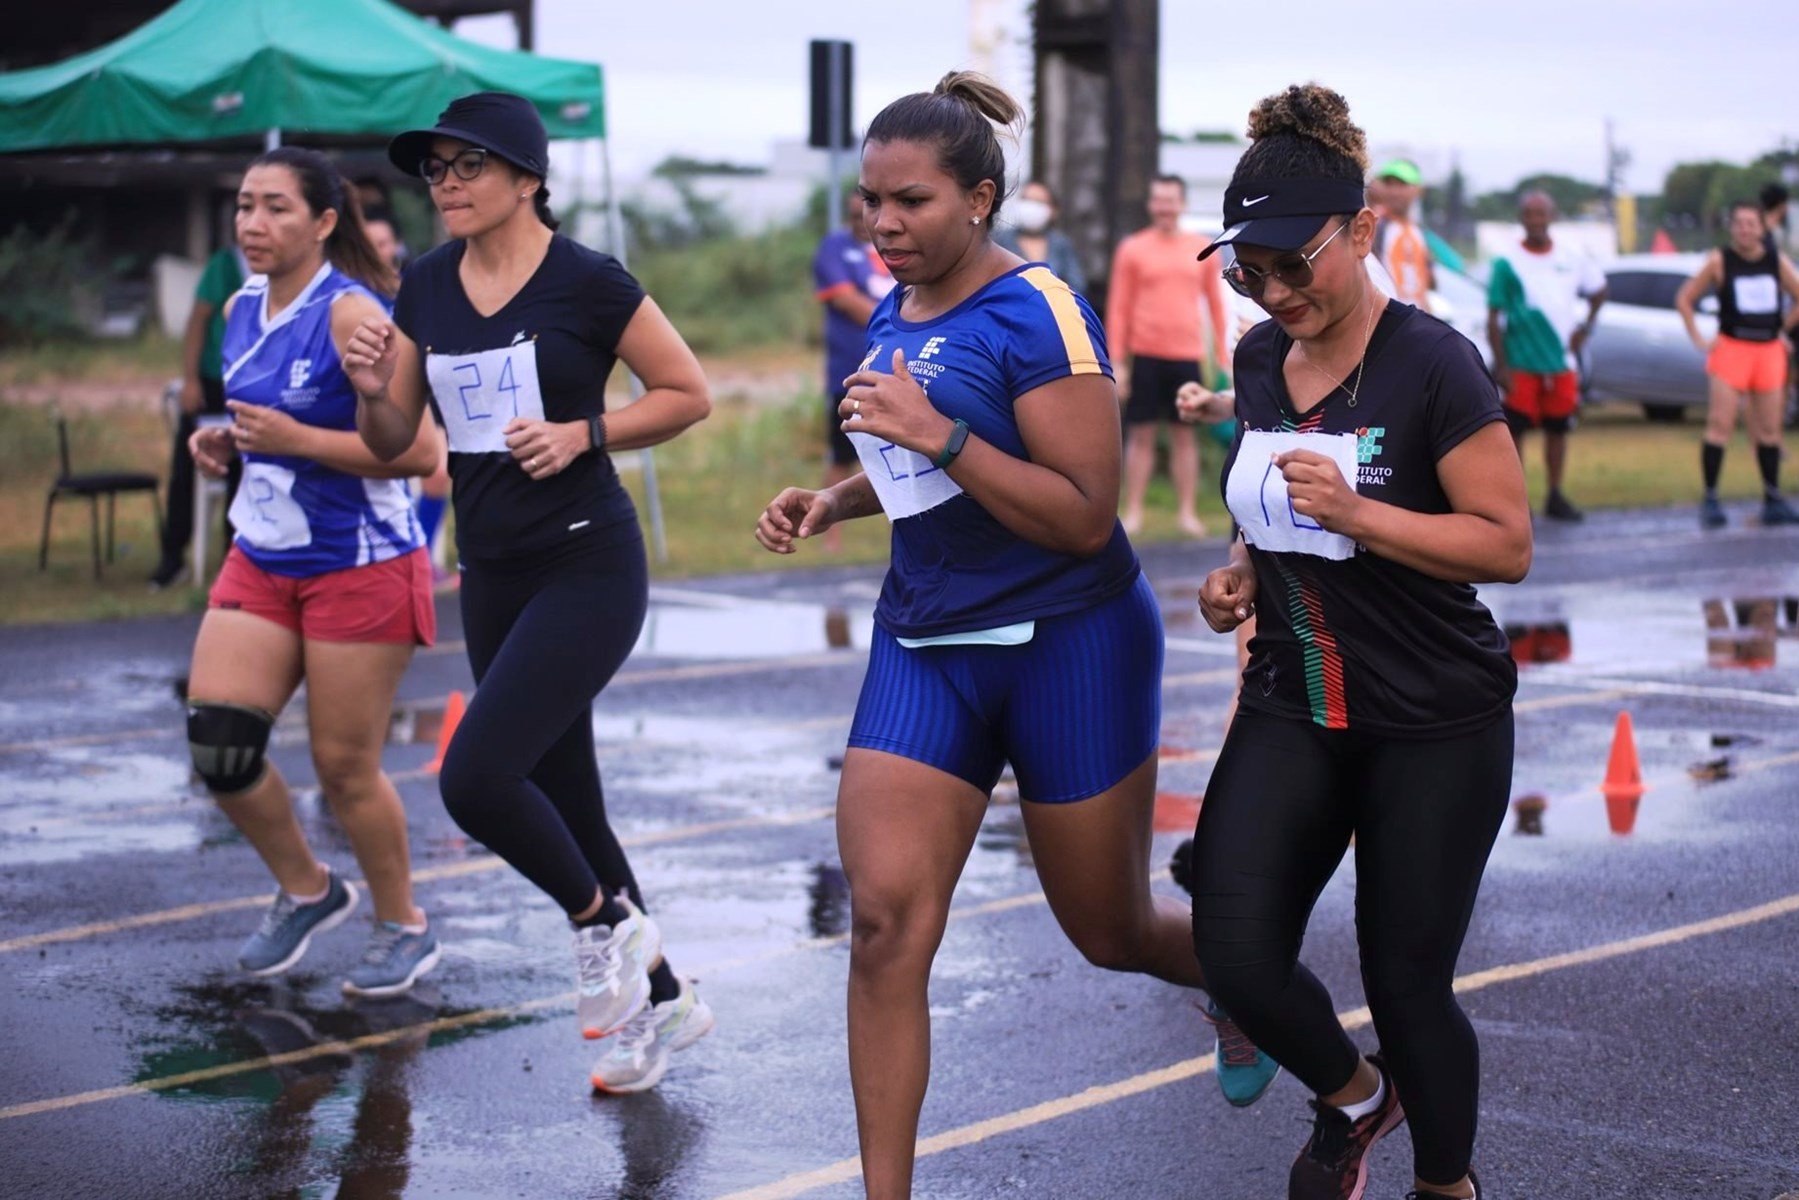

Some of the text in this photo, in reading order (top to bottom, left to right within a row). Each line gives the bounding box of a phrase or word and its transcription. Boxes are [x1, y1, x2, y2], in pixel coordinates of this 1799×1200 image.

[452, 355, 522, 421] 24
[1356, 466, 1393, 477] TITUTO
[1355, 475, 1386, 485] DERAL
